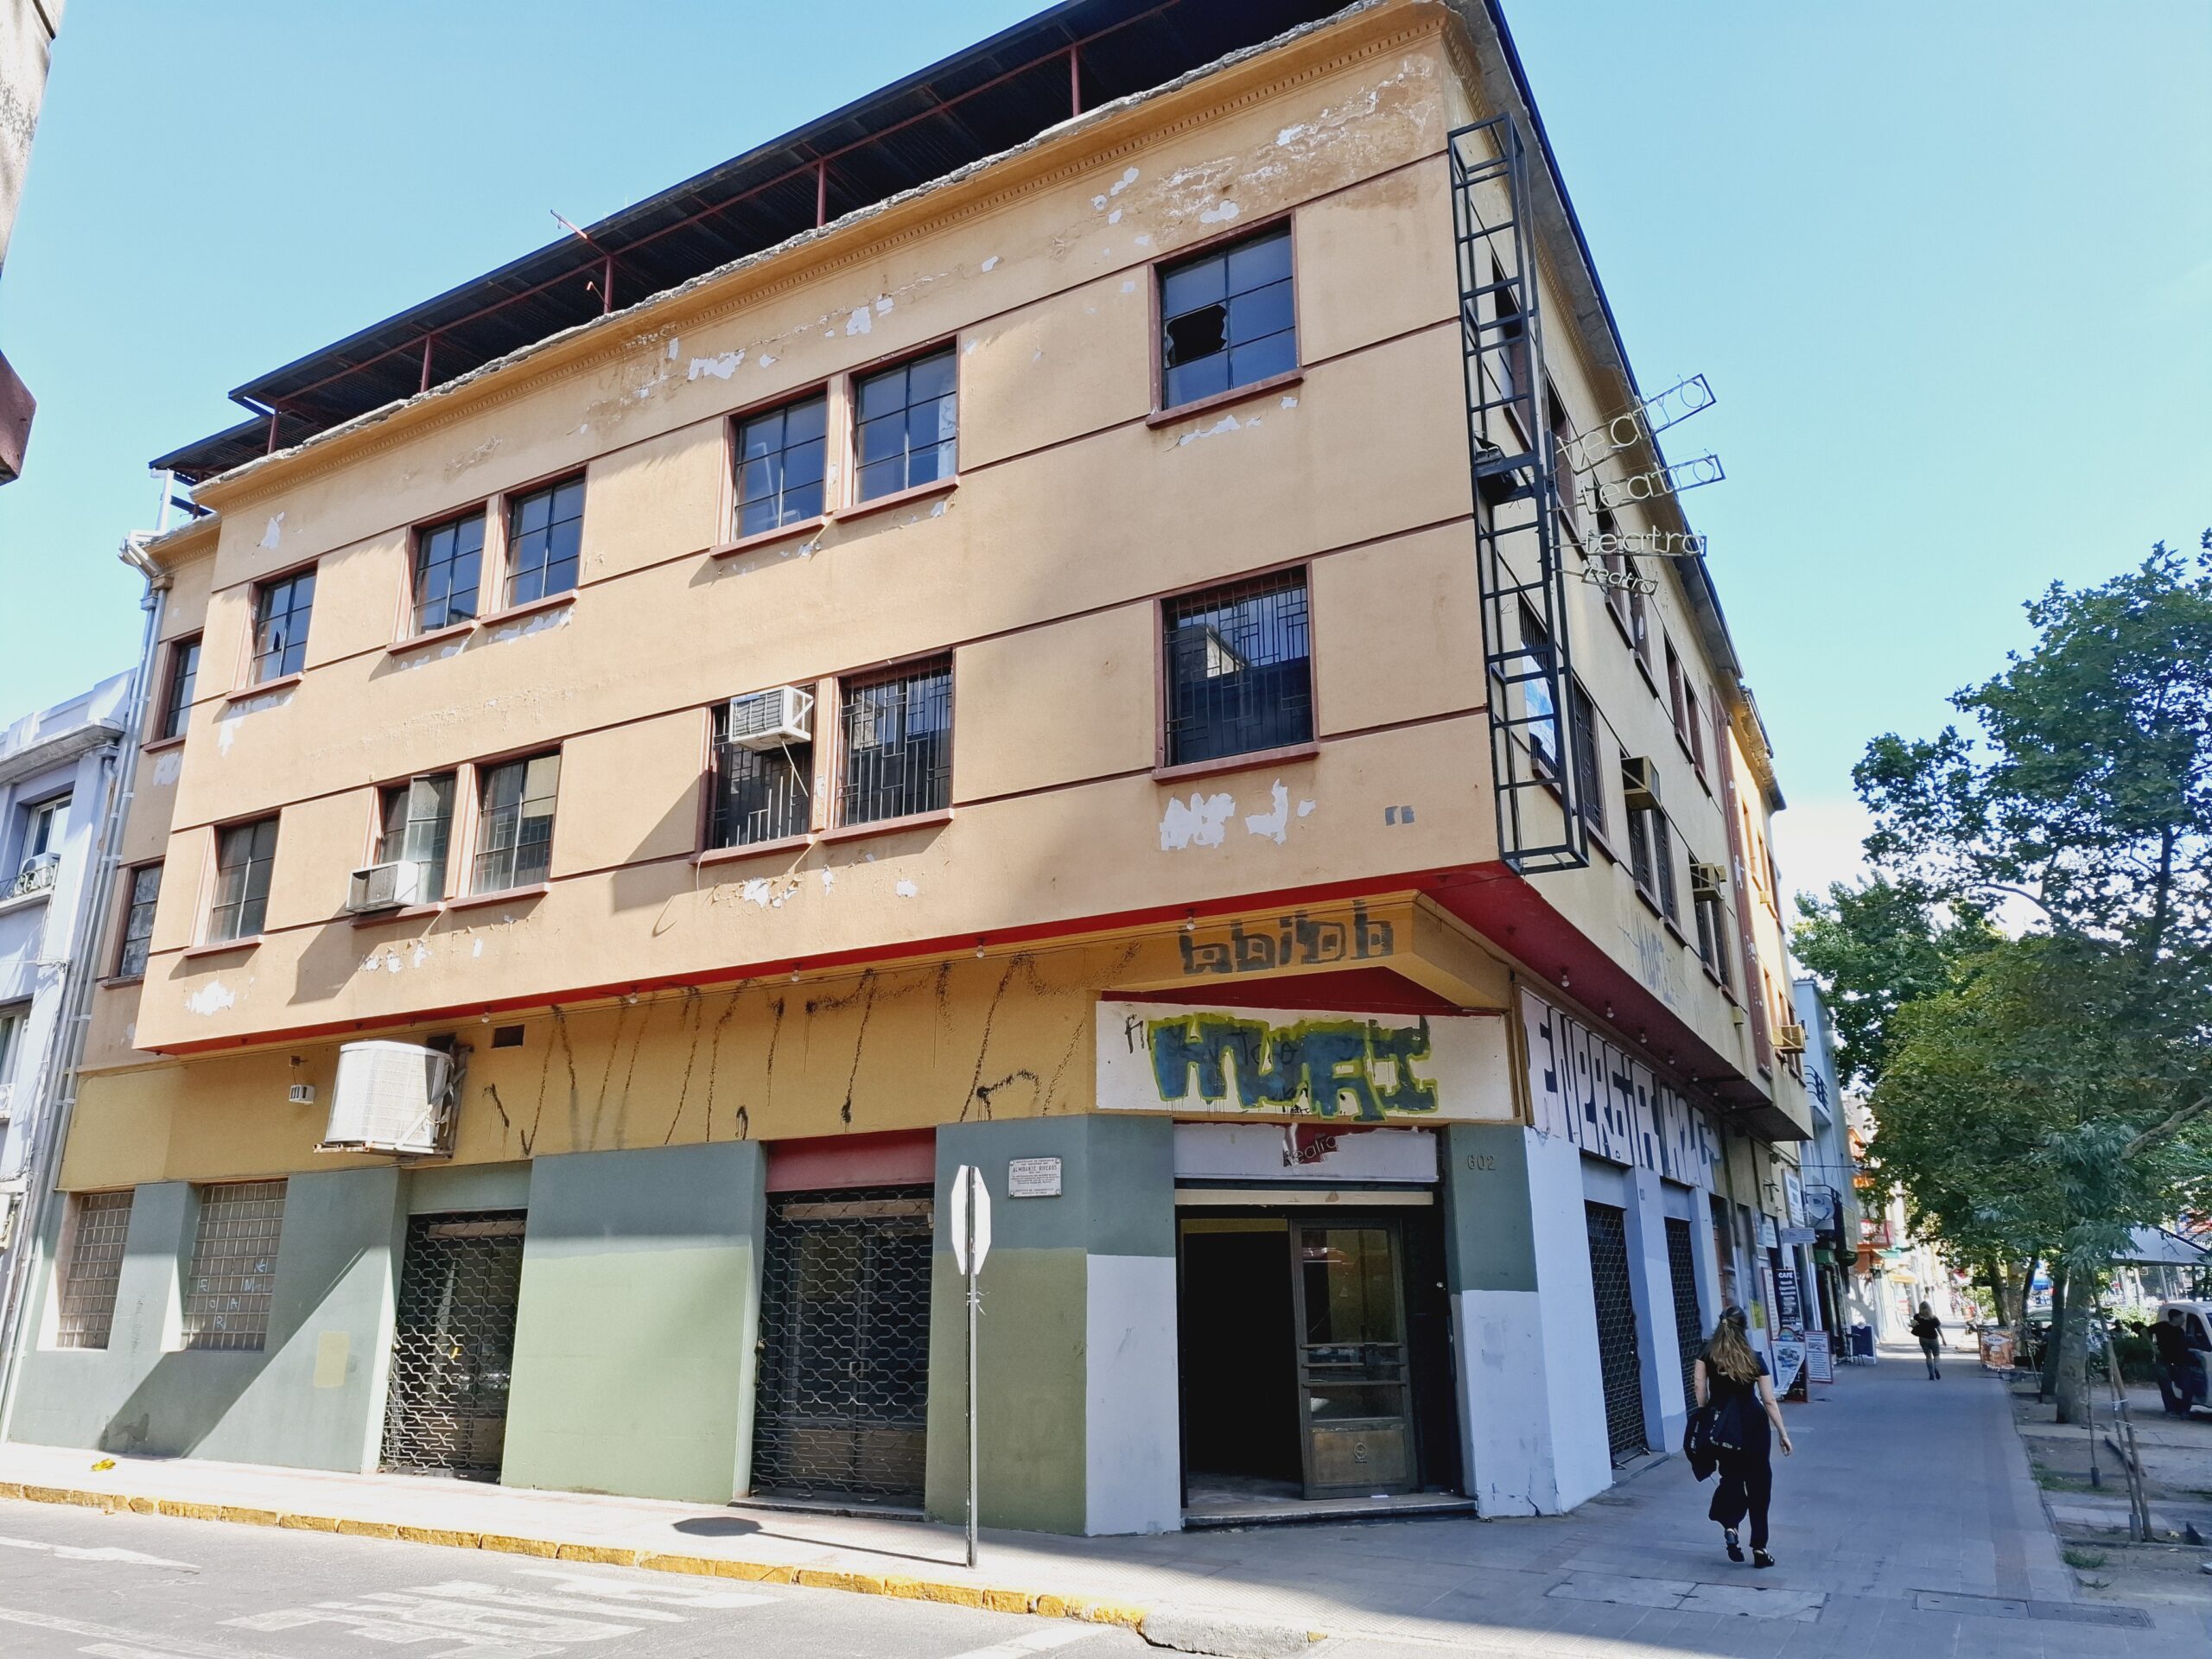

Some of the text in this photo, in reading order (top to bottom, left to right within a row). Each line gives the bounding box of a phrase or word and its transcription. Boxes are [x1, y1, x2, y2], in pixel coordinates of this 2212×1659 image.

[1556, 380, 1707, 474] teatro
[1578, 460, 1716, 514] teatro
[1585, 525, 1704, 555] teatro
[1587, 563, 1656, 594] teatro
[1467, 1155, 1497, 1170] 602
